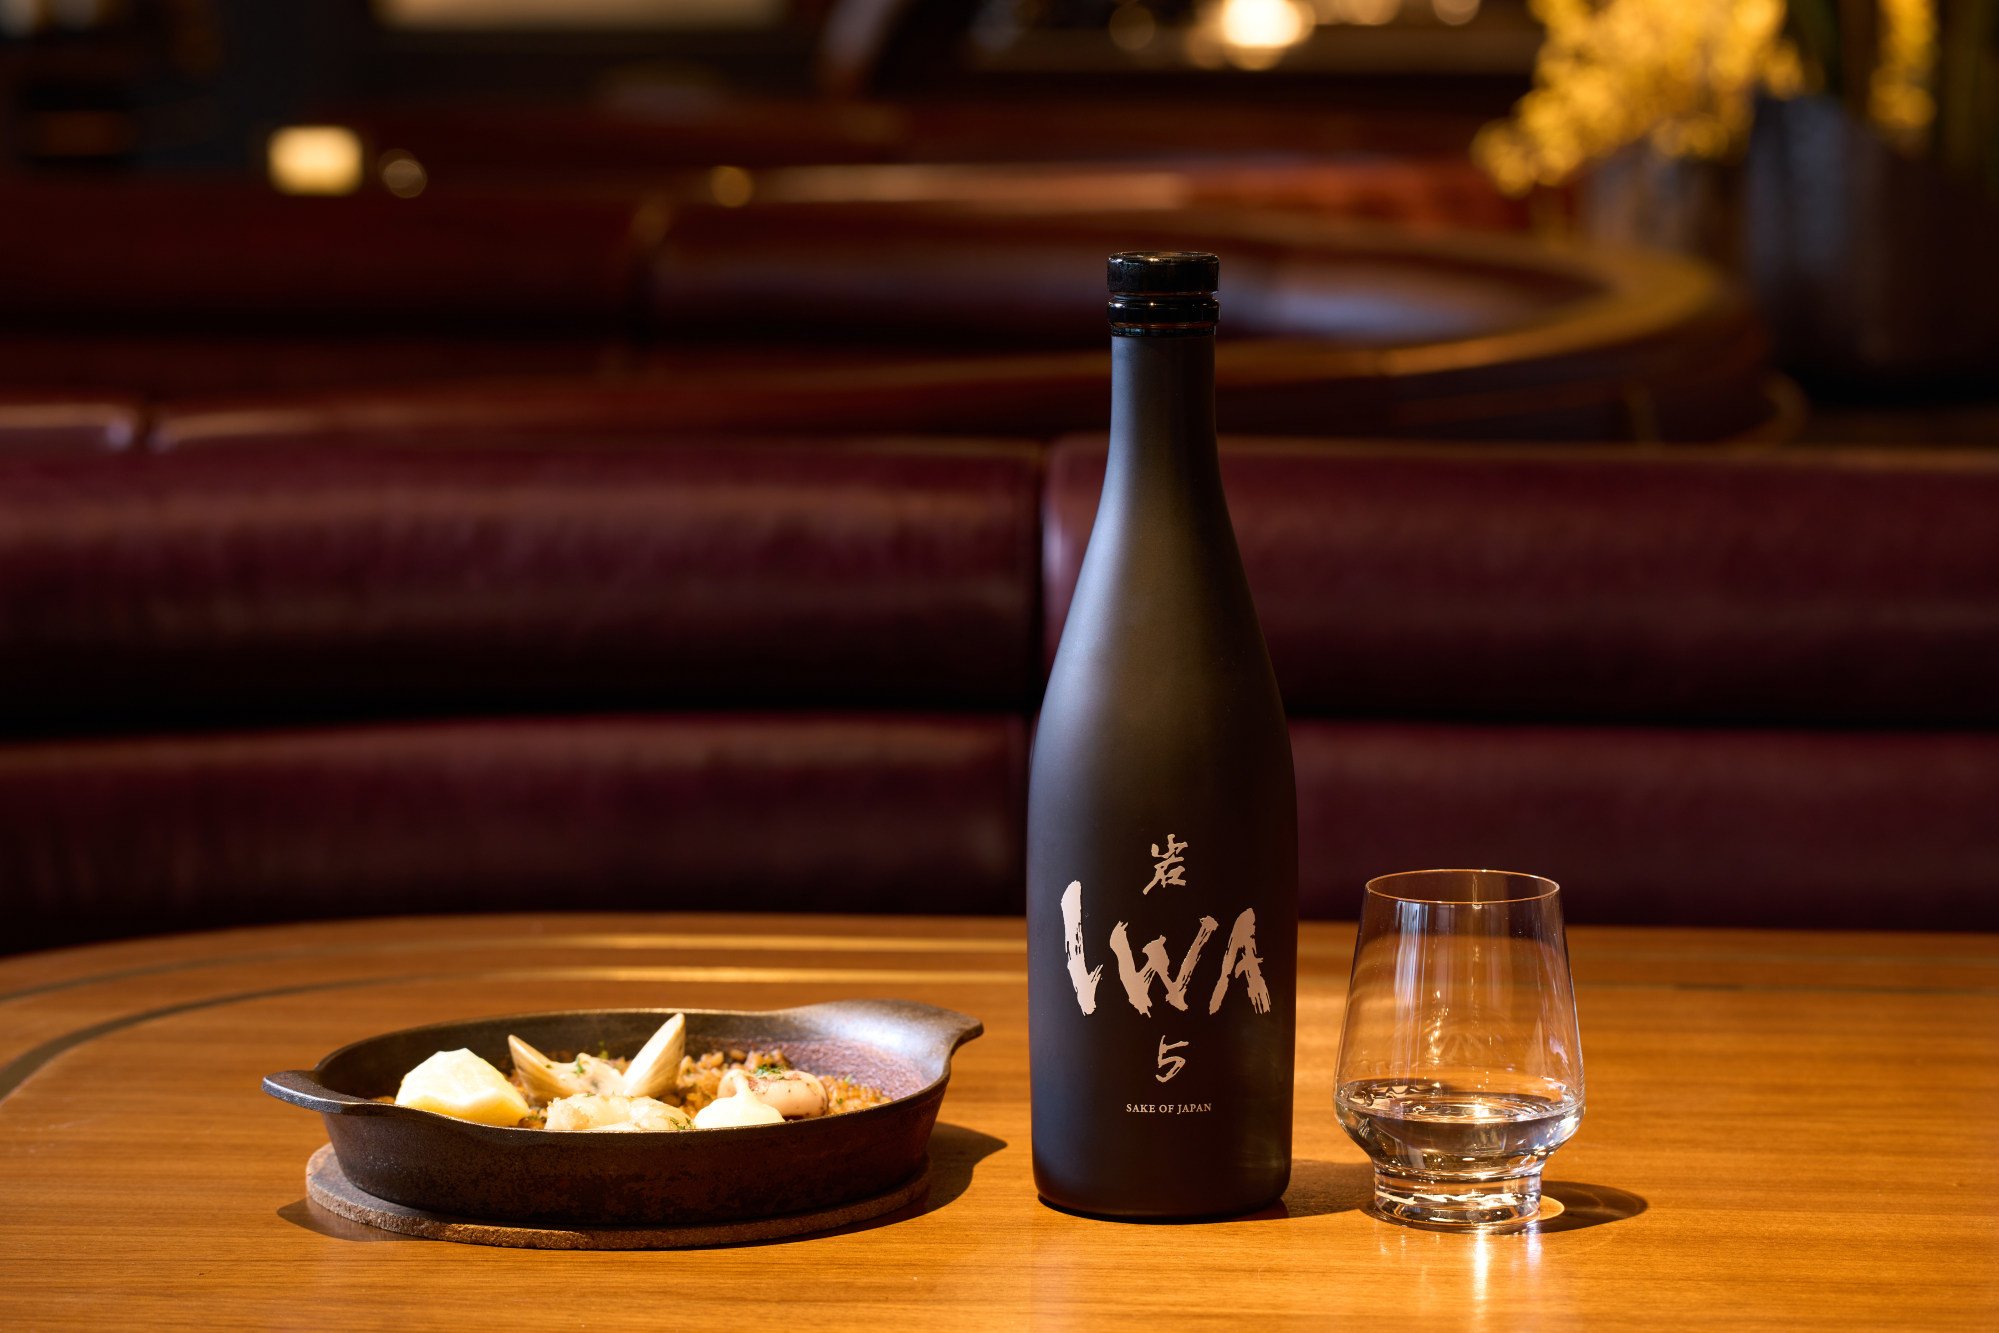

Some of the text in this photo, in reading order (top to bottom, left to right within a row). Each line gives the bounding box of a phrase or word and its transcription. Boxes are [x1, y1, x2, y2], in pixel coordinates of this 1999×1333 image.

[1142, 833, 1189, 895] 岩
[1060, 879, 1272, 1019] IWA
[1155, 1034, 1190, 1083] 5
[1126, 1103, 1212, 1115] SAKE OF JAPAN
